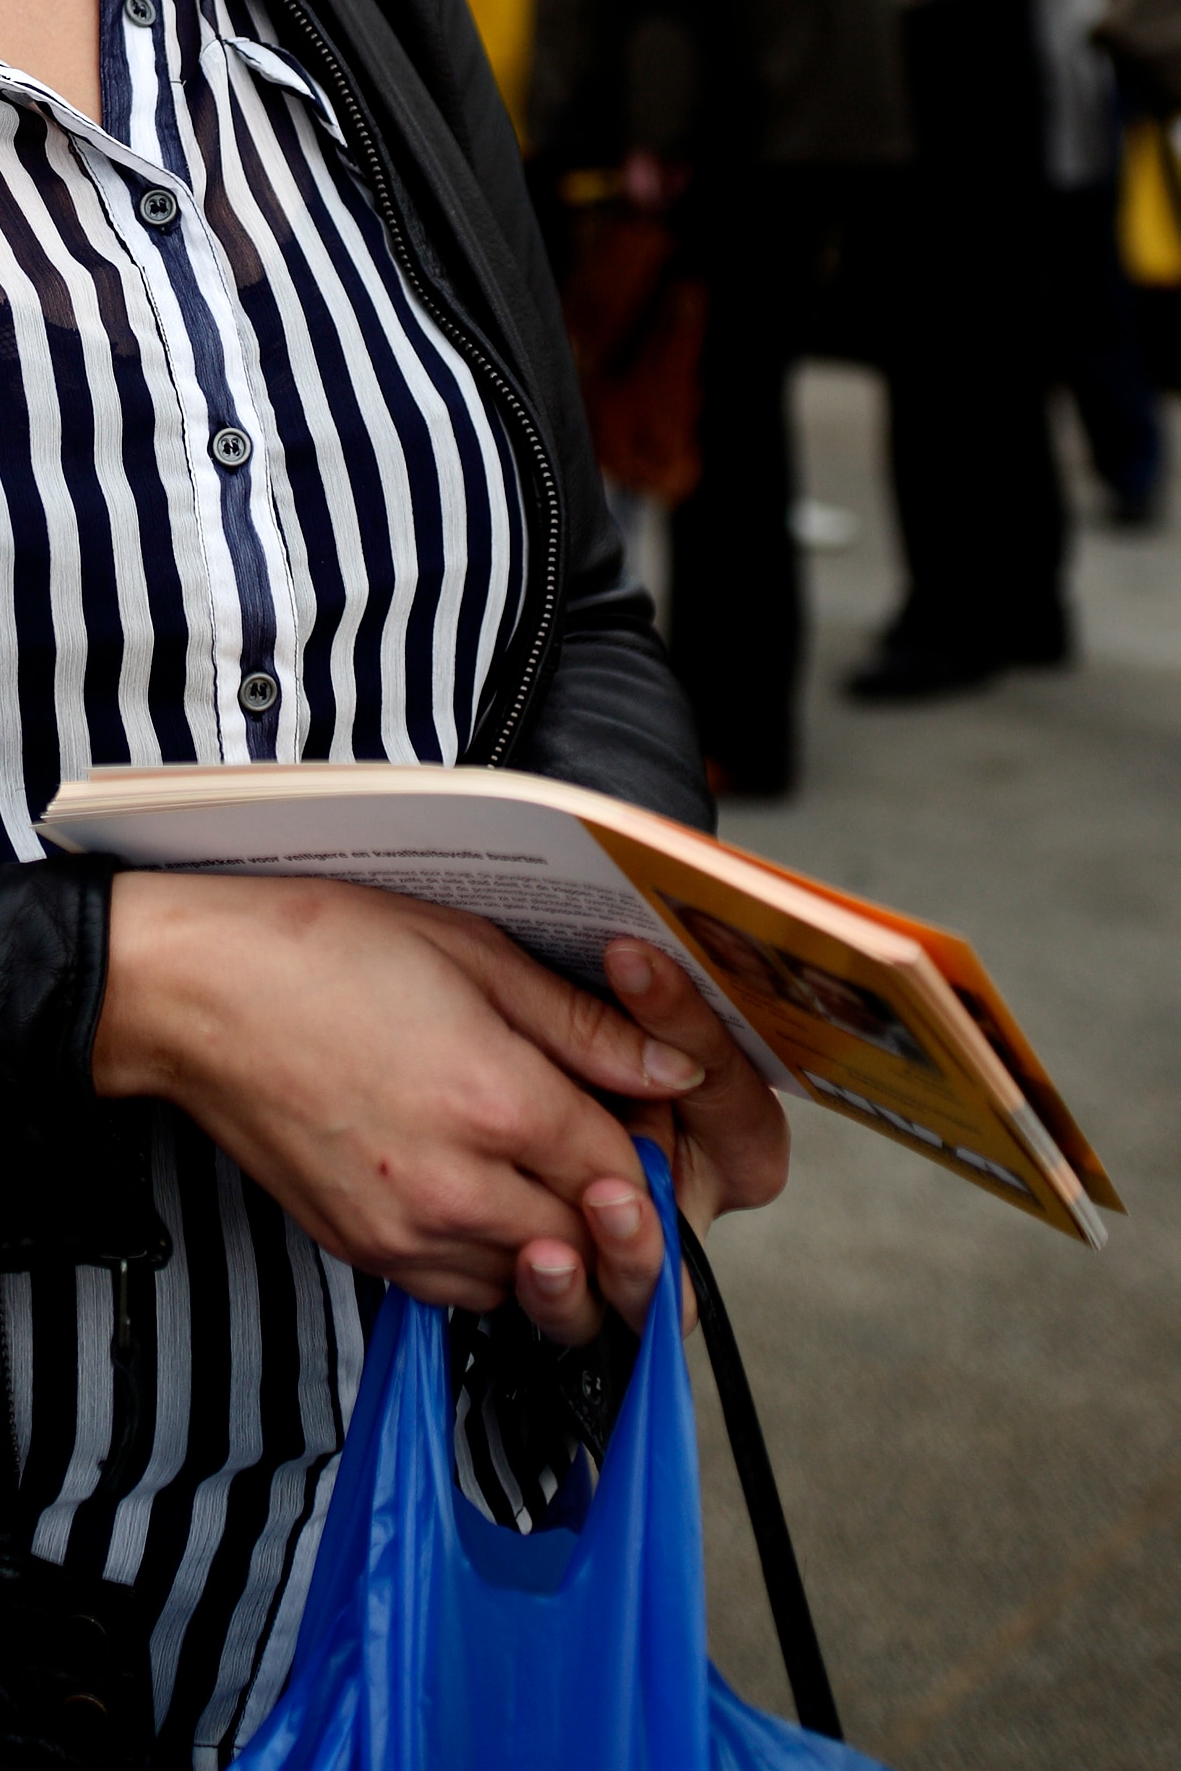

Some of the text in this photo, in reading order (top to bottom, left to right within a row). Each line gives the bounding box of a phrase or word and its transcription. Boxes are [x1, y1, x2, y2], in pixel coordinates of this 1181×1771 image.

[166, 857, 246, 870] aanpakken
[248, 854, 280, 865] voor
[284, 850, 349, 863] veiligere
[351, 850, 371, 859] en
